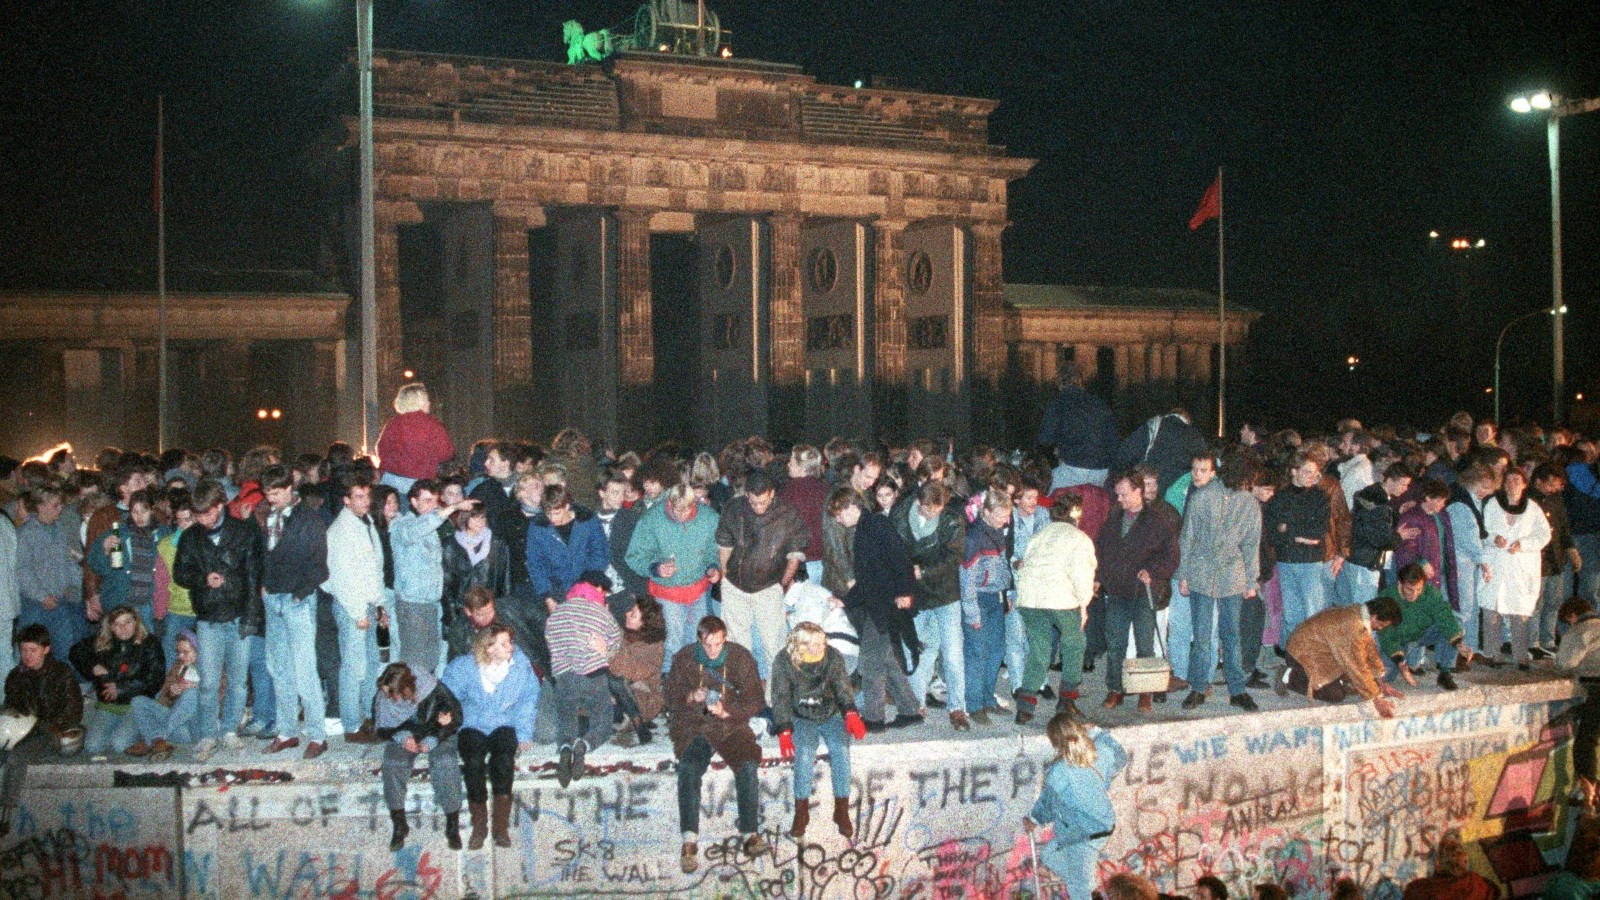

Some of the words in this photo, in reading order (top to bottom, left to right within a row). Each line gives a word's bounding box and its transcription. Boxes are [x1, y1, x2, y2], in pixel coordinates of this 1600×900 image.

[1174, 735, 1228, 764] WIE
[1395, 707, 1502, 739] MACHEN
[187, 796, 270, 834] ALL
[292, 790, 340, 827] OF
[555, 779, 658, 825] THE
[909, 753, 999, 809] THE
[553, 839, 615, 861] SK8
[601, 862, 672, 884] WALL
